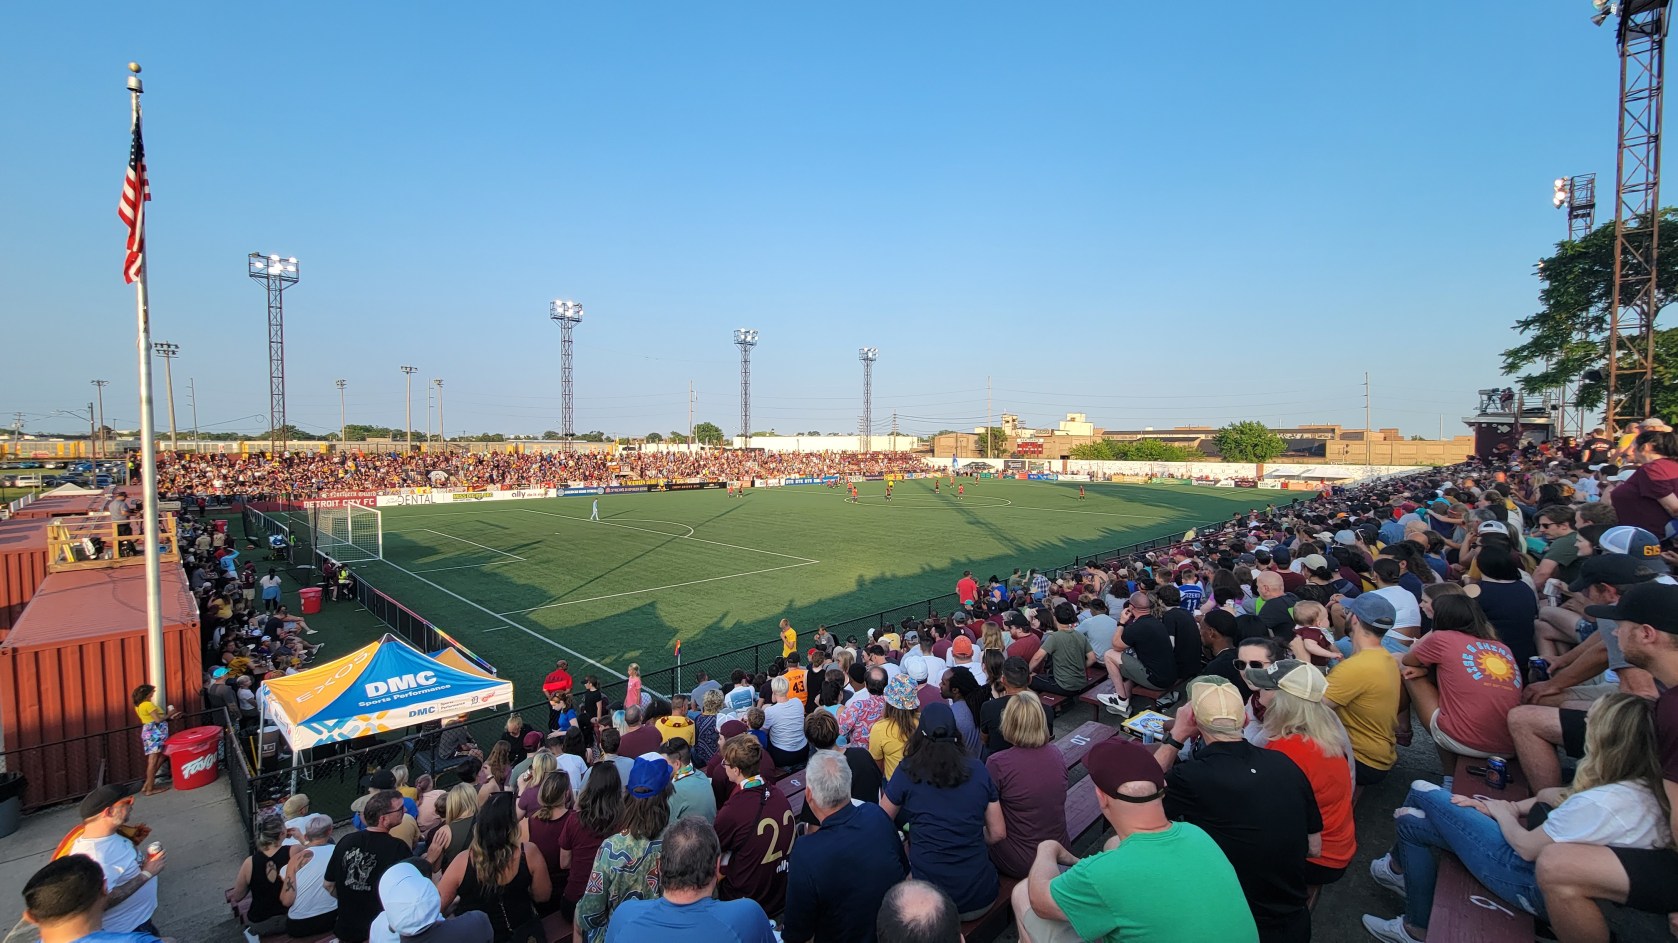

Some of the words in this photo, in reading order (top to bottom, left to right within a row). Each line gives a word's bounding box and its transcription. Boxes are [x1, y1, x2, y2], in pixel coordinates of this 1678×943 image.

[397, 494, 437, 506] DENTAL
[511, 491, 526, 499] ally
[303, 500, 340, 508] DETROIT
[342, 499, 361, 507] CITY
[1186, 599, 1198, 610] 11
[296, 651, 369, 703] EXOS
[365, 670, 437, 698] DMC
[792, 680, 805, 693] 43
[358, 696, 392, 708] Sports
[393, 684, 451, 700] Performance
[408, 706, 436, 717] DMC
[757, 809, 797, 865] 22
